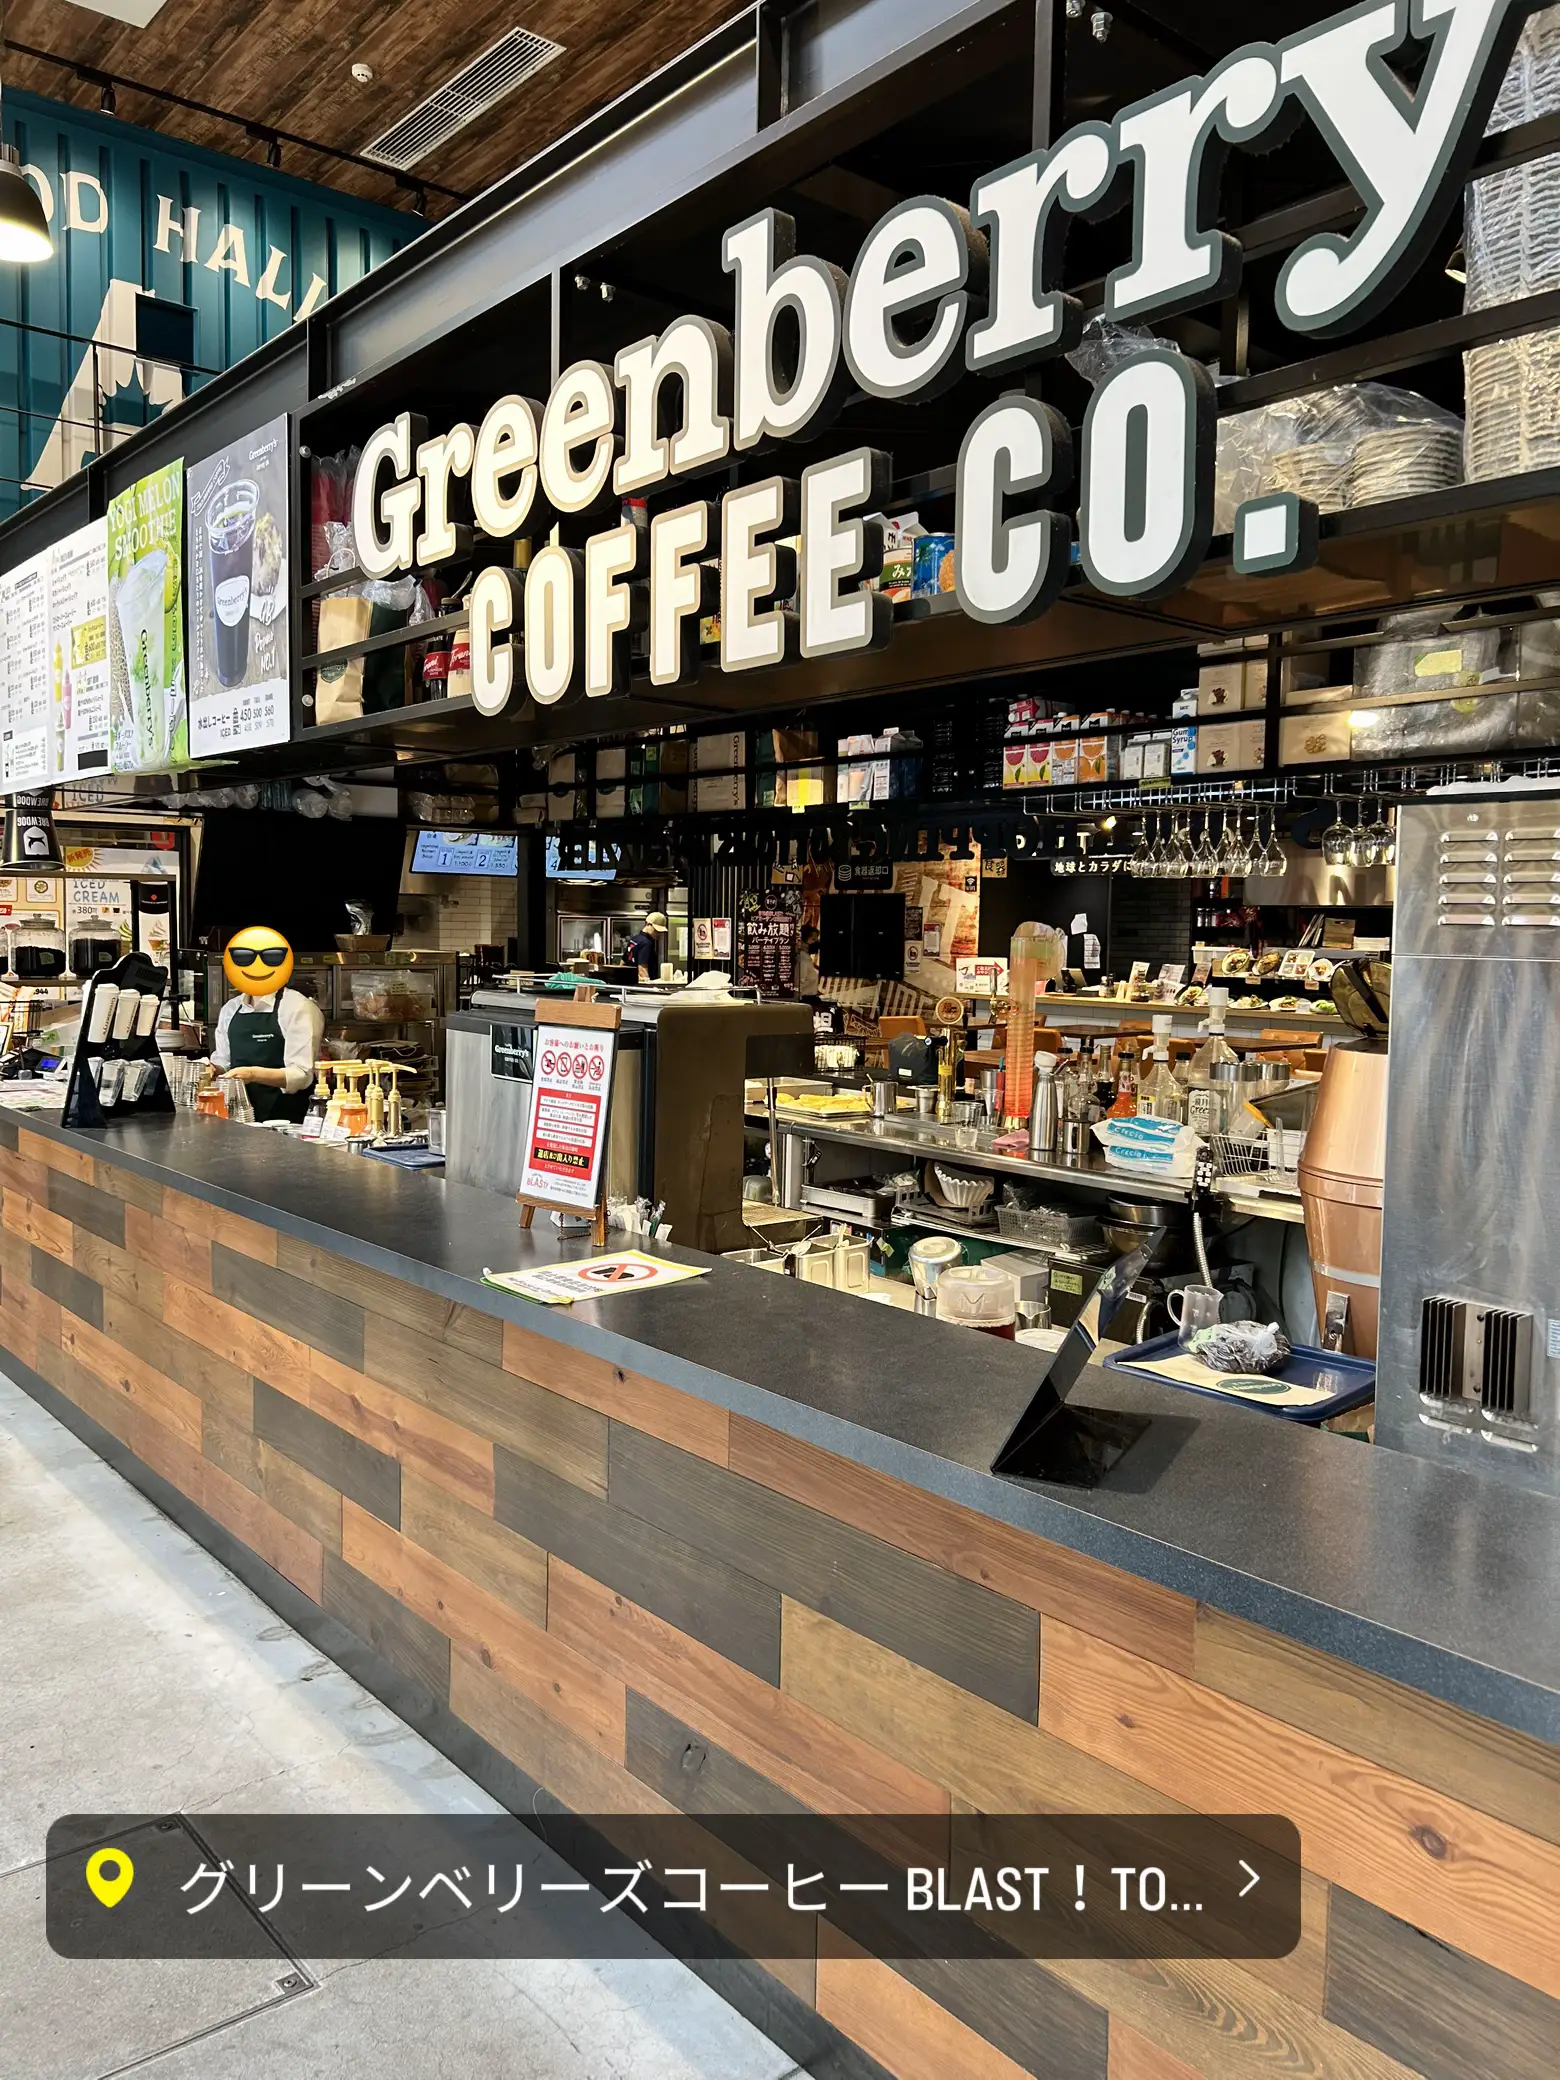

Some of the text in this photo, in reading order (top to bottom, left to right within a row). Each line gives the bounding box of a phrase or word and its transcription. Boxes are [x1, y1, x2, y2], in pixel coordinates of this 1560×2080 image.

[353, 0, 1511, 580] Greenberry
[138, 472, 180, 517] MELON
[469, 446, 876, 717] COFFEE
[955, 347, 1300, 624] CO.
[141, 629, 154, 748] Greenberry's
[240, 708, 252, 722] 450
[1173, 736, 1193, 745] Syrup
[854, 866, 889, 876] 食器返却口
[73, 890, 120, 904] CREAM
[746, 923, 790, 936] 飲み放題
[494, 1044, 530, 1059] Greenberry's
